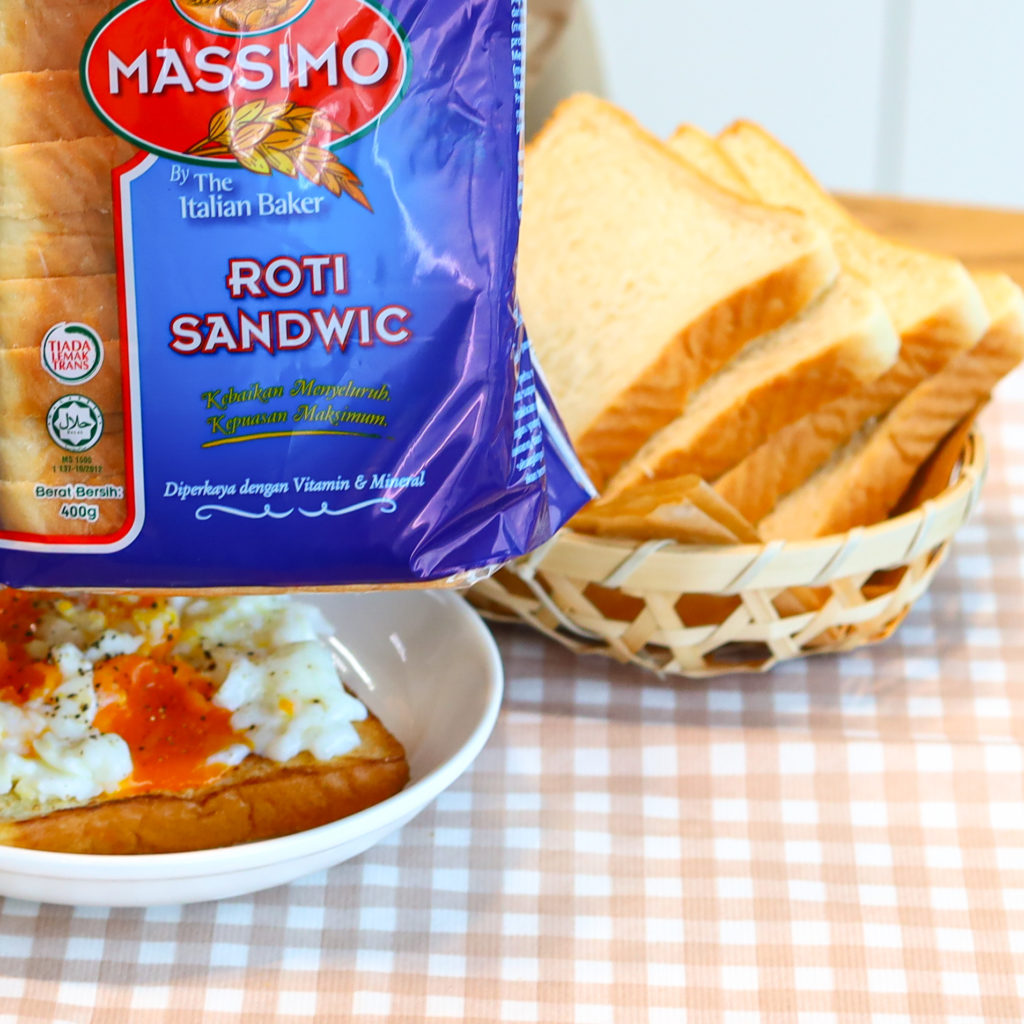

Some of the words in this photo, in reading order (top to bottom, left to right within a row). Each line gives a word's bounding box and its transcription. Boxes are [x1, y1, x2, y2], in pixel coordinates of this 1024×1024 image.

[107, 38, 390, 96] MASSIMO
[169, 164, 190, 186] By
[193, 172, 233, 193] The
[179, 193, 252, 220] Italian
[258, 192, 325, 217] Baker
[226, 253, 349, 299] ROTI
[169, 303, 413, 356] SANDWIC
[48, 339, 92, 352] TIADA
[51, 351, 89, 362] LEMAK
[52, 359, 90, 371] TRANS
[200, 382, 284, 411] Kebaikan
[289, 379, 392, 403] Menyeluruh.
[207, 409, 289, 435] Kepuasan
[292, 404, 388, 427] Maksimum.
[35, 485, 72, 498] Berat
[75, 485, 123, 498] Bersih:
[163, 480, 236, 502] Diperkaya
[239, 478, 289, 499] dengan
[293, 475, 350, 493] Vitamin
[354, 474, 368, 490] &
[369, 470, 426, 490] Mineral
[61, 504, 97, 521] 400g
